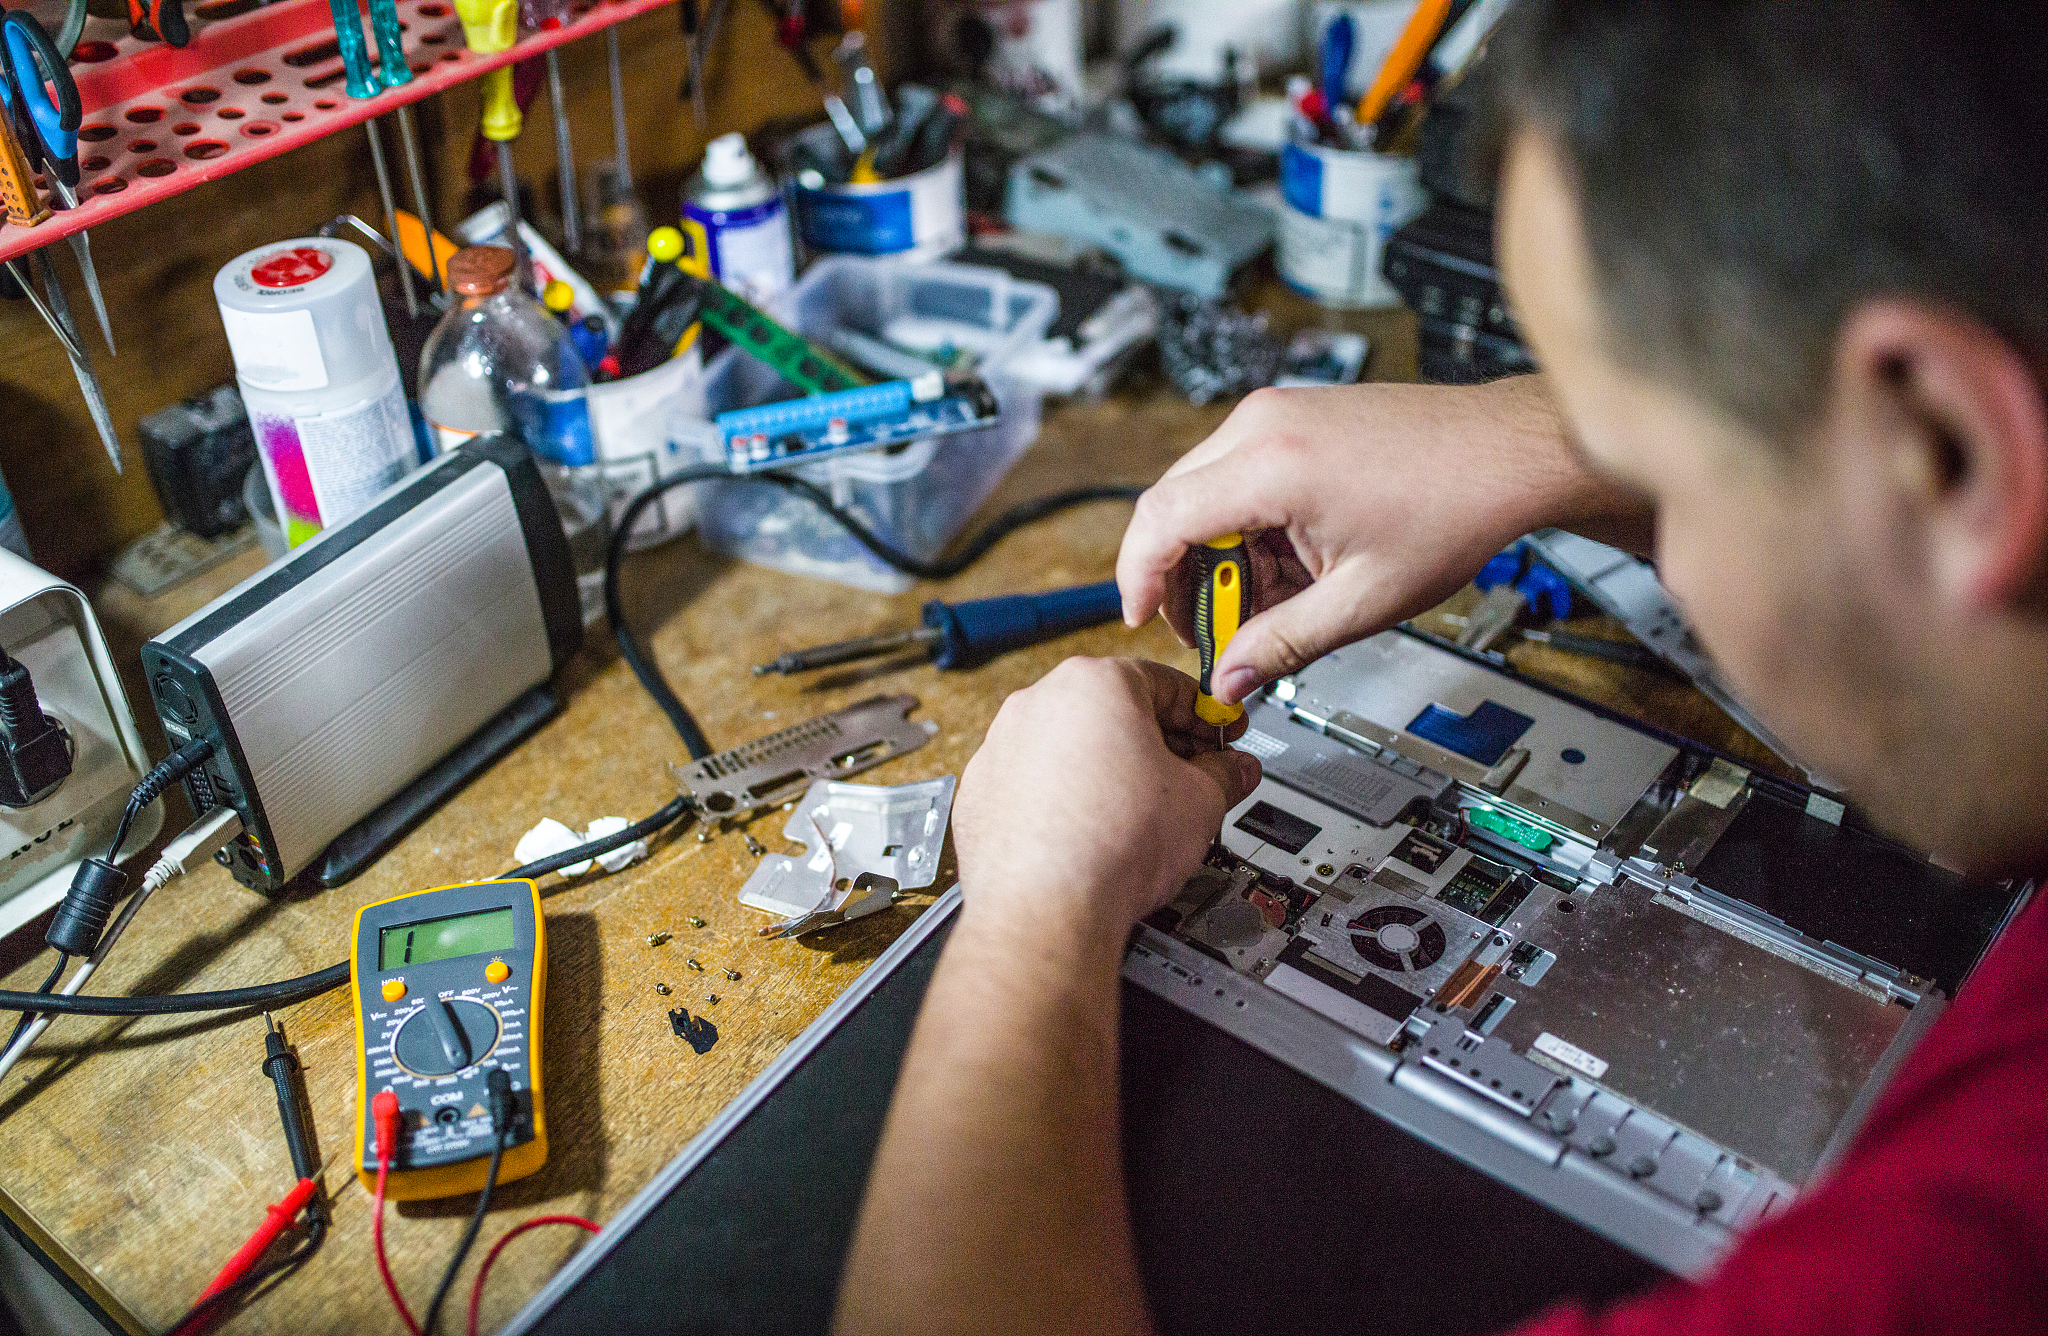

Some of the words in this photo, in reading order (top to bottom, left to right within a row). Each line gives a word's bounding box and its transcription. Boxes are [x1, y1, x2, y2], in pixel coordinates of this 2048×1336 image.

[404, 931, 414, 964] 1
[438, 989, 455, 999] OFF
[461, 987, 481, 996] 600V
[481, 991, 501, 1000] 200V
[430, 1090, 464, 1106] COM
